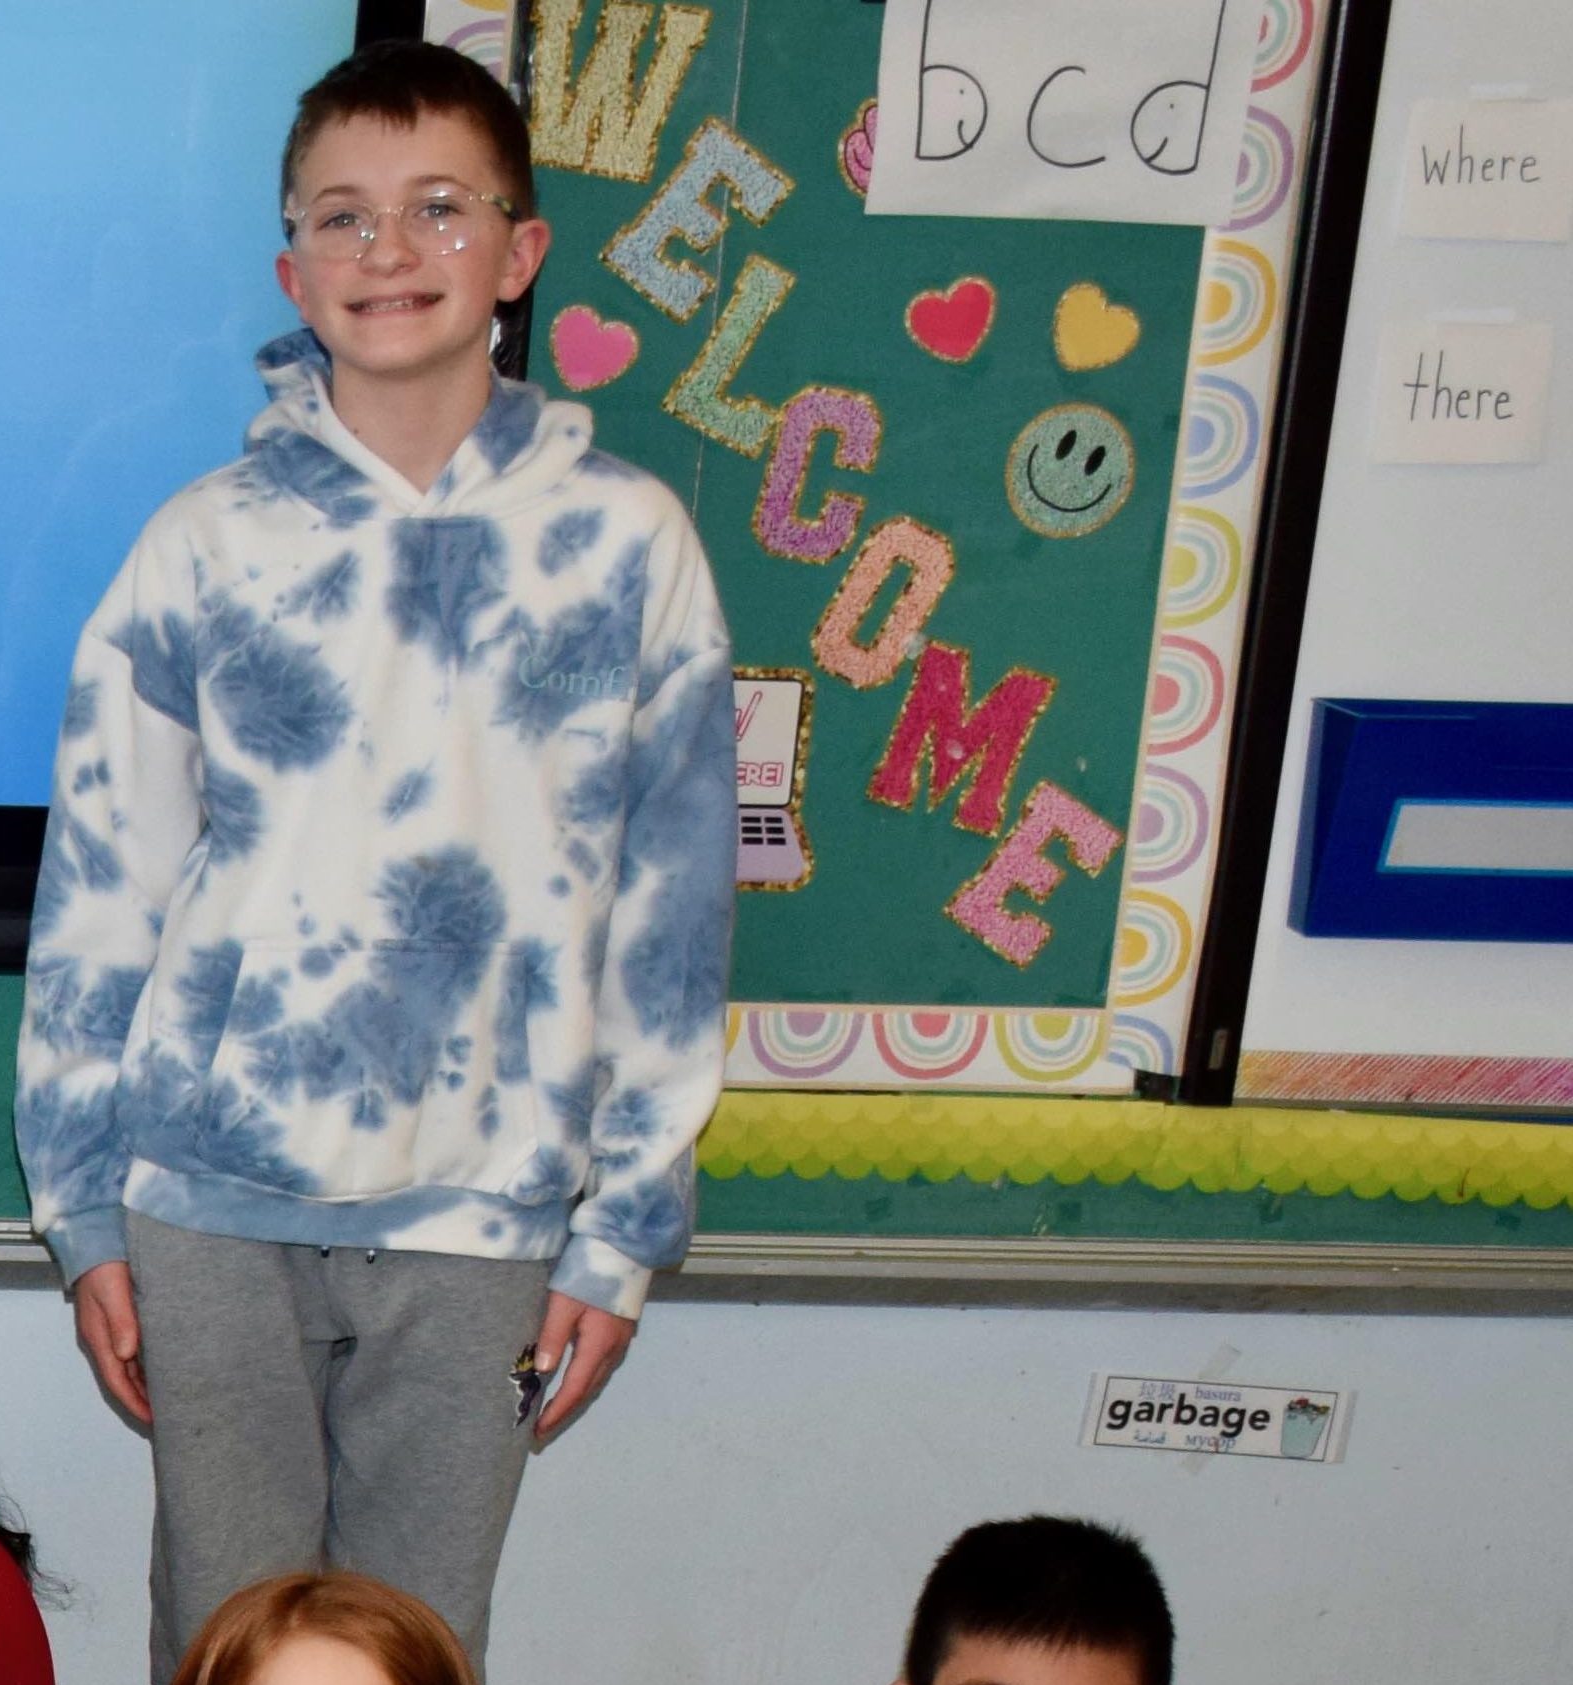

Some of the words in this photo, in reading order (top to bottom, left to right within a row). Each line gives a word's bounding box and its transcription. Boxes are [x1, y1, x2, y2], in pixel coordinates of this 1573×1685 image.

[1421, 124, 1541, 185] where
[1403, 349, 1513, 421] there
[529, 0, 1125, 969] WELCOME
[1106, 1392, 1271, 1438] garbage
[1194, 1385, 1243, 1402] basura
